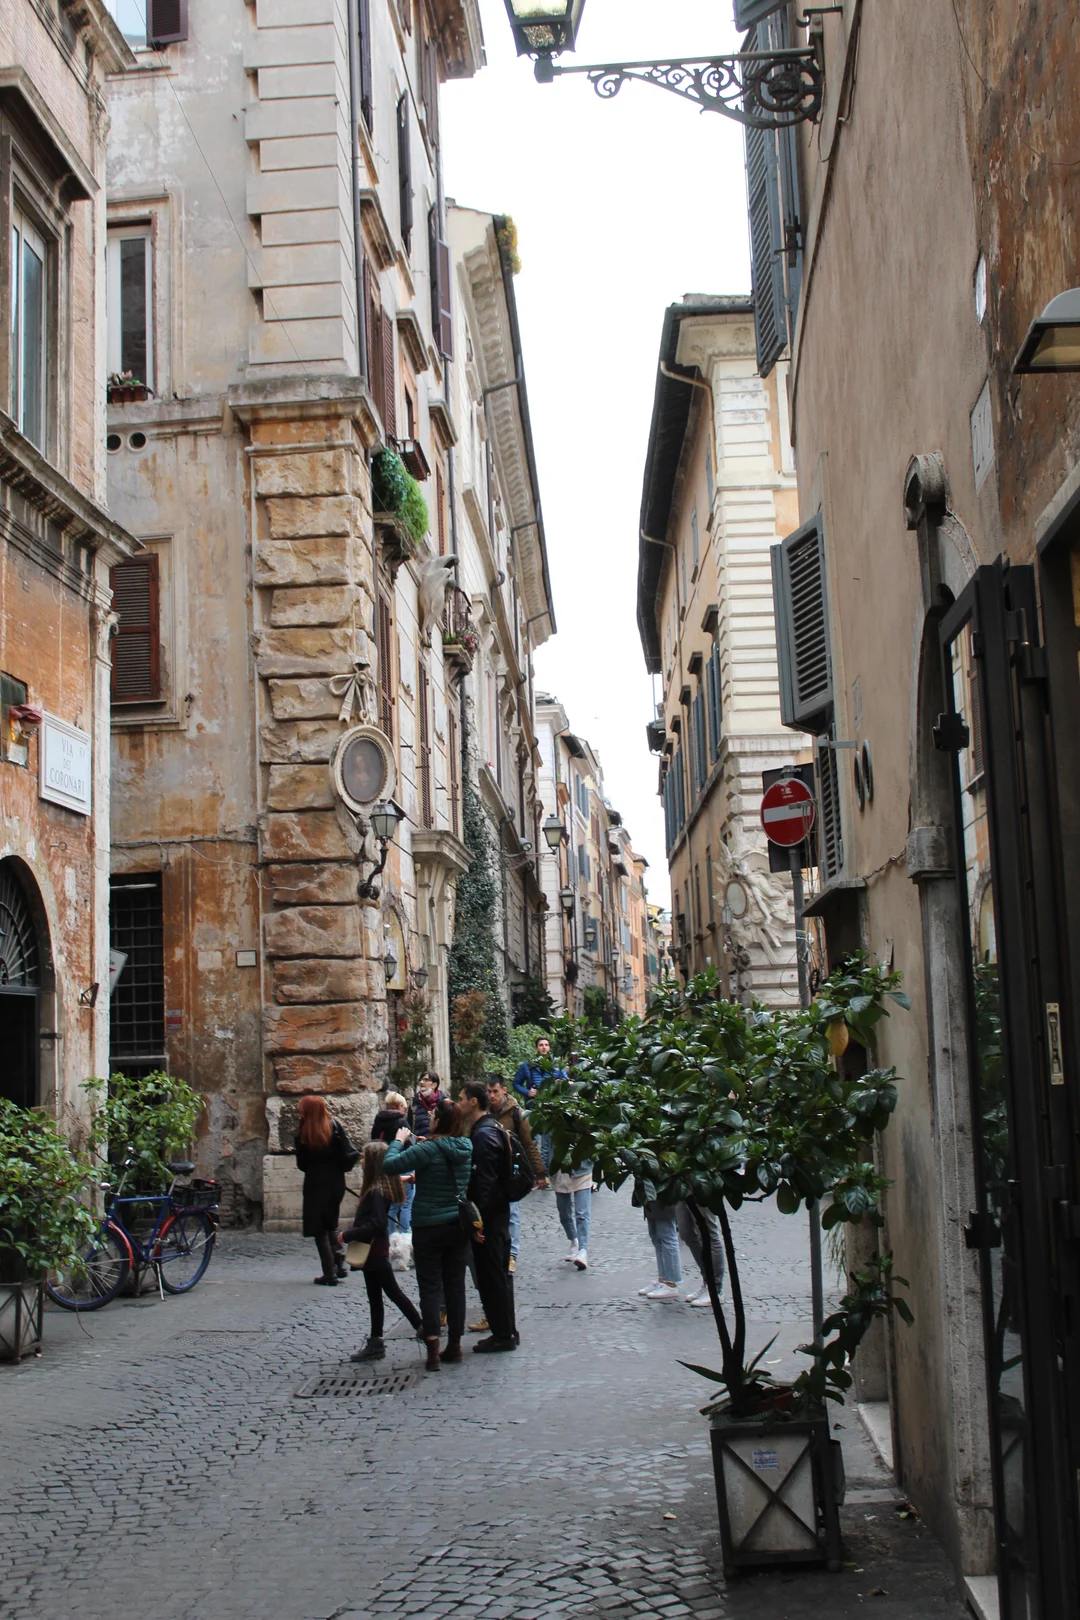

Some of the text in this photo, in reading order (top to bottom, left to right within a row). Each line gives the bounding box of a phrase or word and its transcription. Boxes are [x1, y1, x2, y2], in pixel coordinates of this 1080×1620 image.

[61, 737, 74, 758] VIA
[63, 757, 72, 771] DEI
[49, 767, 85, 796] CORONARI
